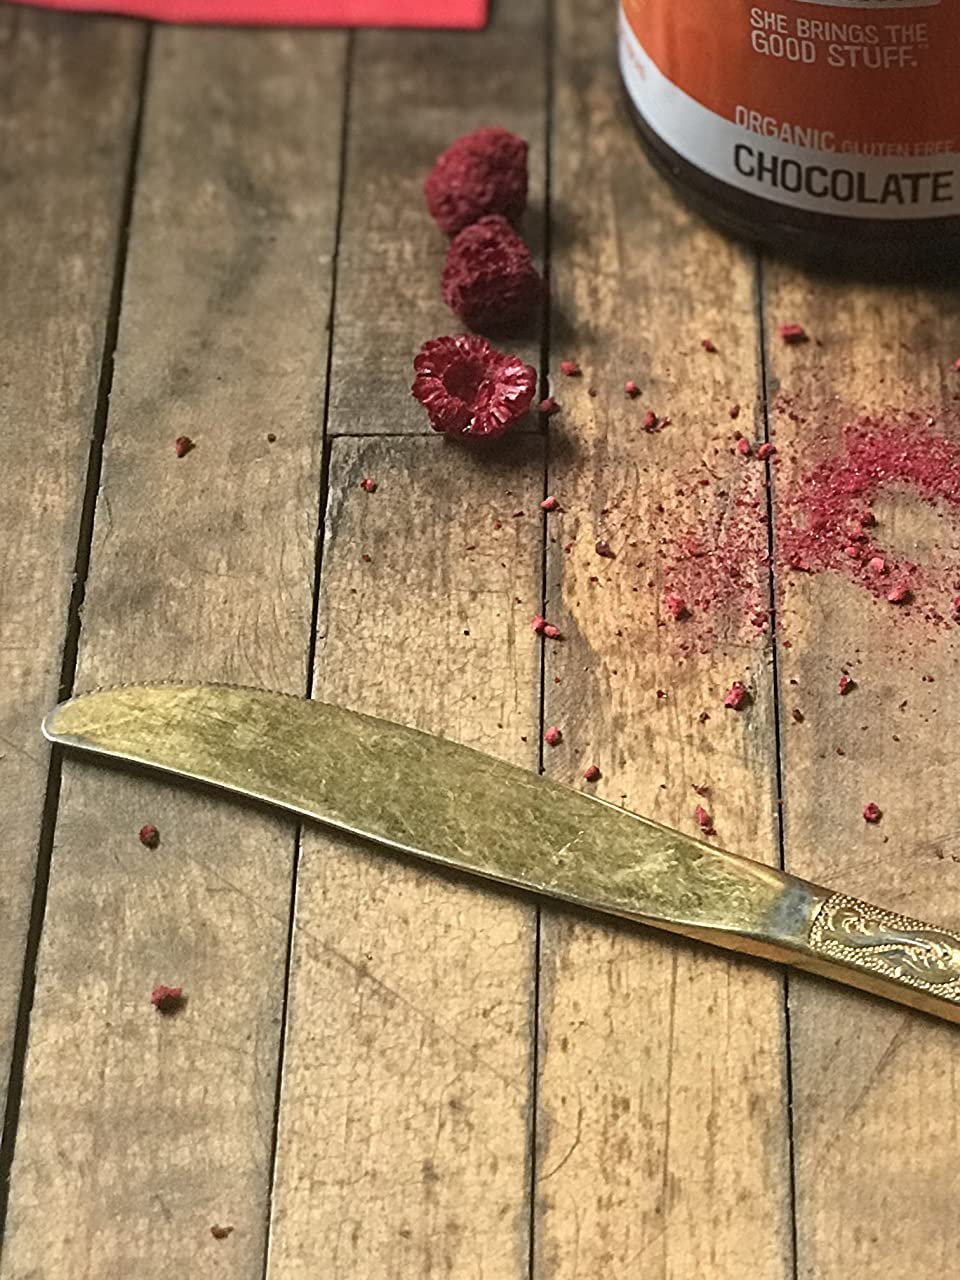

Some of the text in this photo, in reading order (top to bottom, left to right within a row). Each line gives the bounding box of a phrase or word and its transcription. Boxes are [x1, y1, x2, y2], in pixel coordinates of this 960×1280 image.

[750, 8, 928, 44] SHE BRINGS THE
[751, 30, 918, 68] GOOD STUFF.
[734, 104, 835, 153] ORGANIC
[841, 139, 909, 158] GLUTEN
[913, 140, 954, 157] FREE
[734, 143, 954, 205] CHOCOLATE
